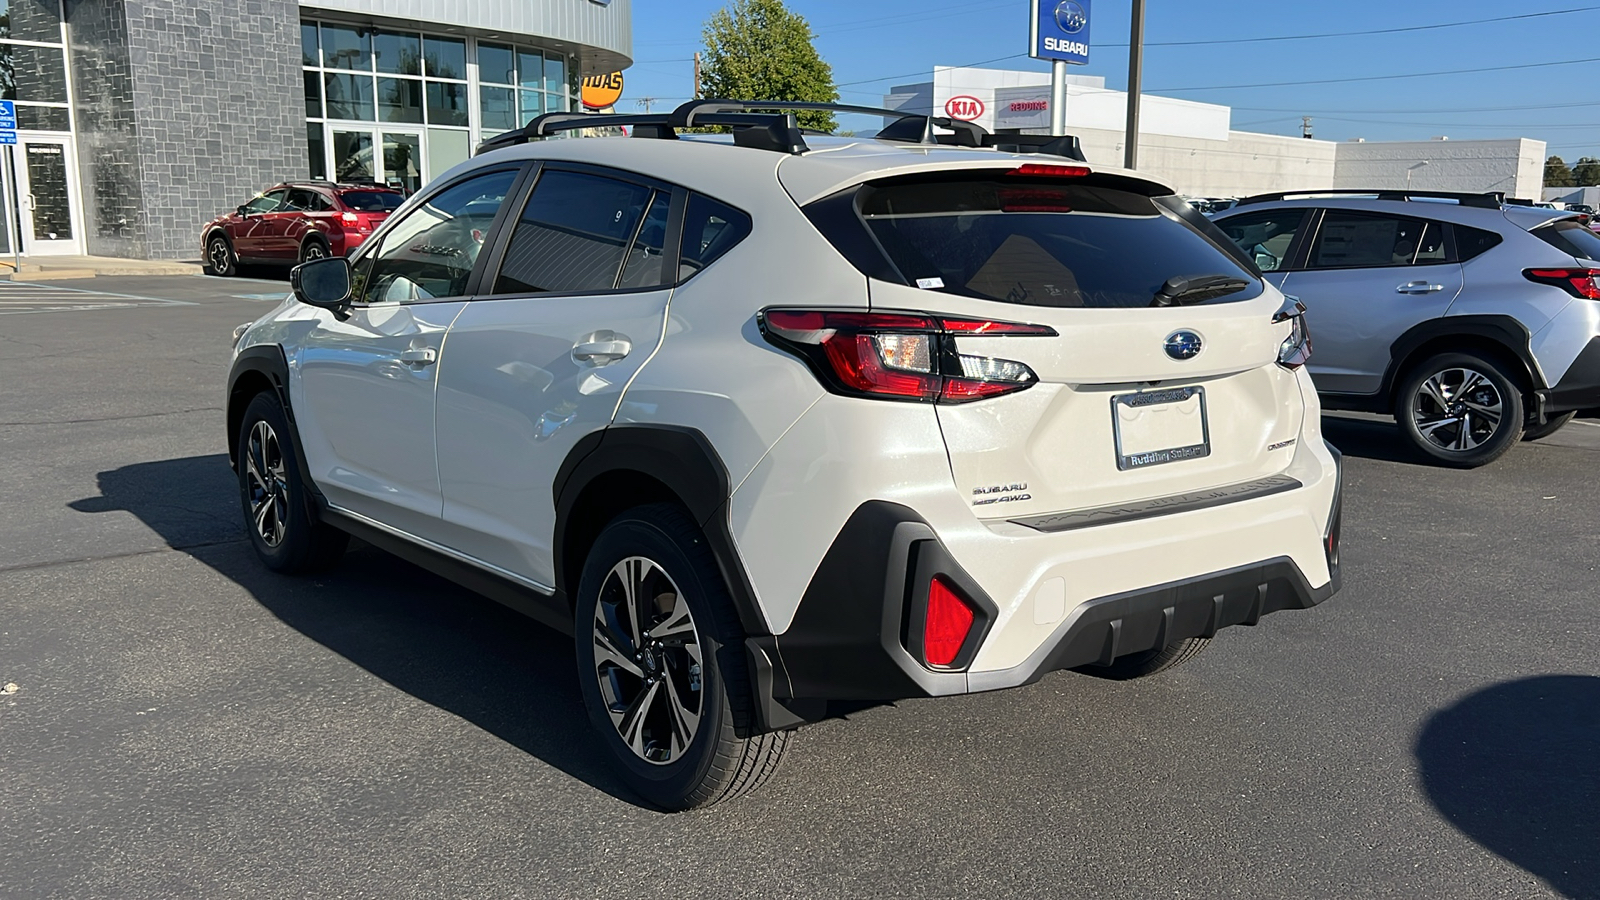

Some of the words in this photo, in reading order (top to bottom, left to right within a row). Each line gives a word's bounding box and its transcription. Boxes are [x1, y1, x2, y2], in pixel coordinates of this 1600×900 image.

[1044, 37, 1088, 57] SUBARU
[951, 101, 978, 116] KIA
[1009, 101, 1048, 112] REDDING
[973, 483, 1028, 495] SUBARU
